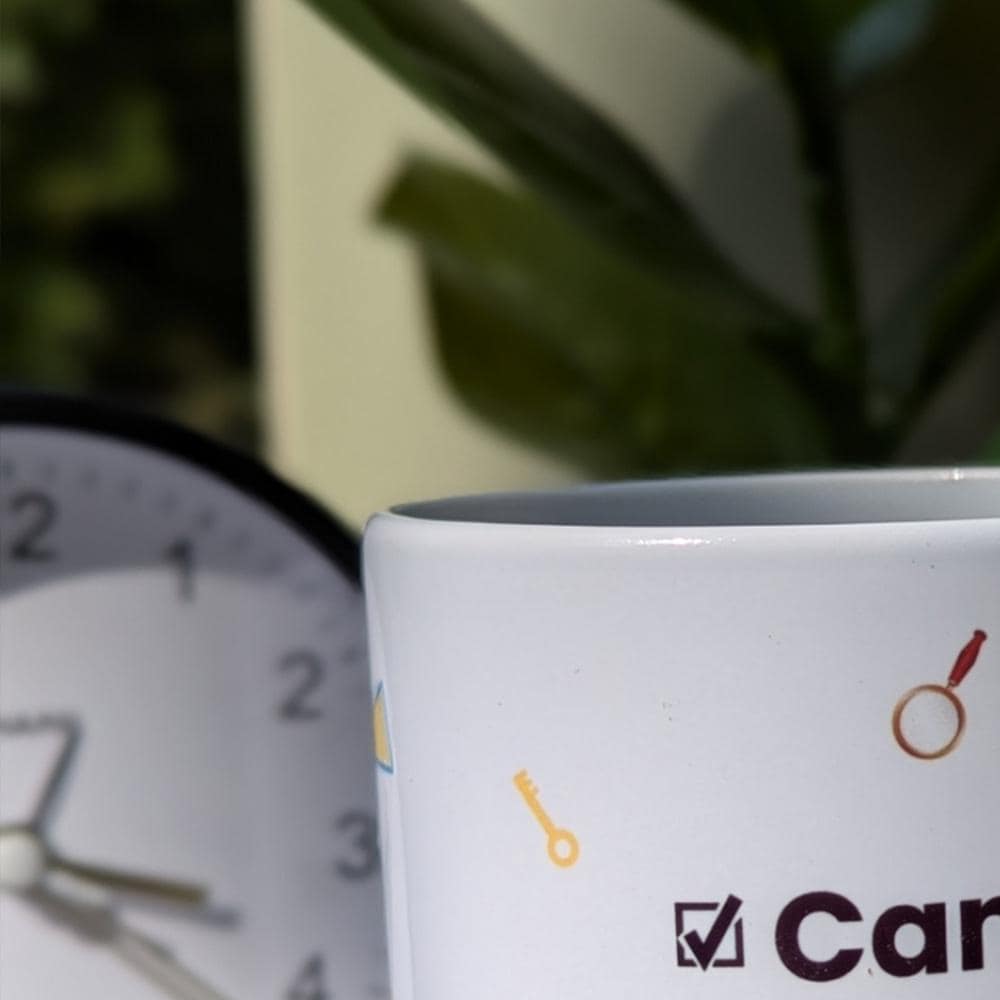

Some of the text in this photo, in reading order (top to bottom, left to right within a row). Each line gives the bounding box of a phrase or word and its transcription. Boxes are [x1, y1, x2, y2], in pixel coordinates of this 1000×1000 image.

[5, 490, 58, 564] 2
[162, 537, 196, 604] 1
[276, 649, 325, 722] 2
[334, 810, 380, 881] 3
